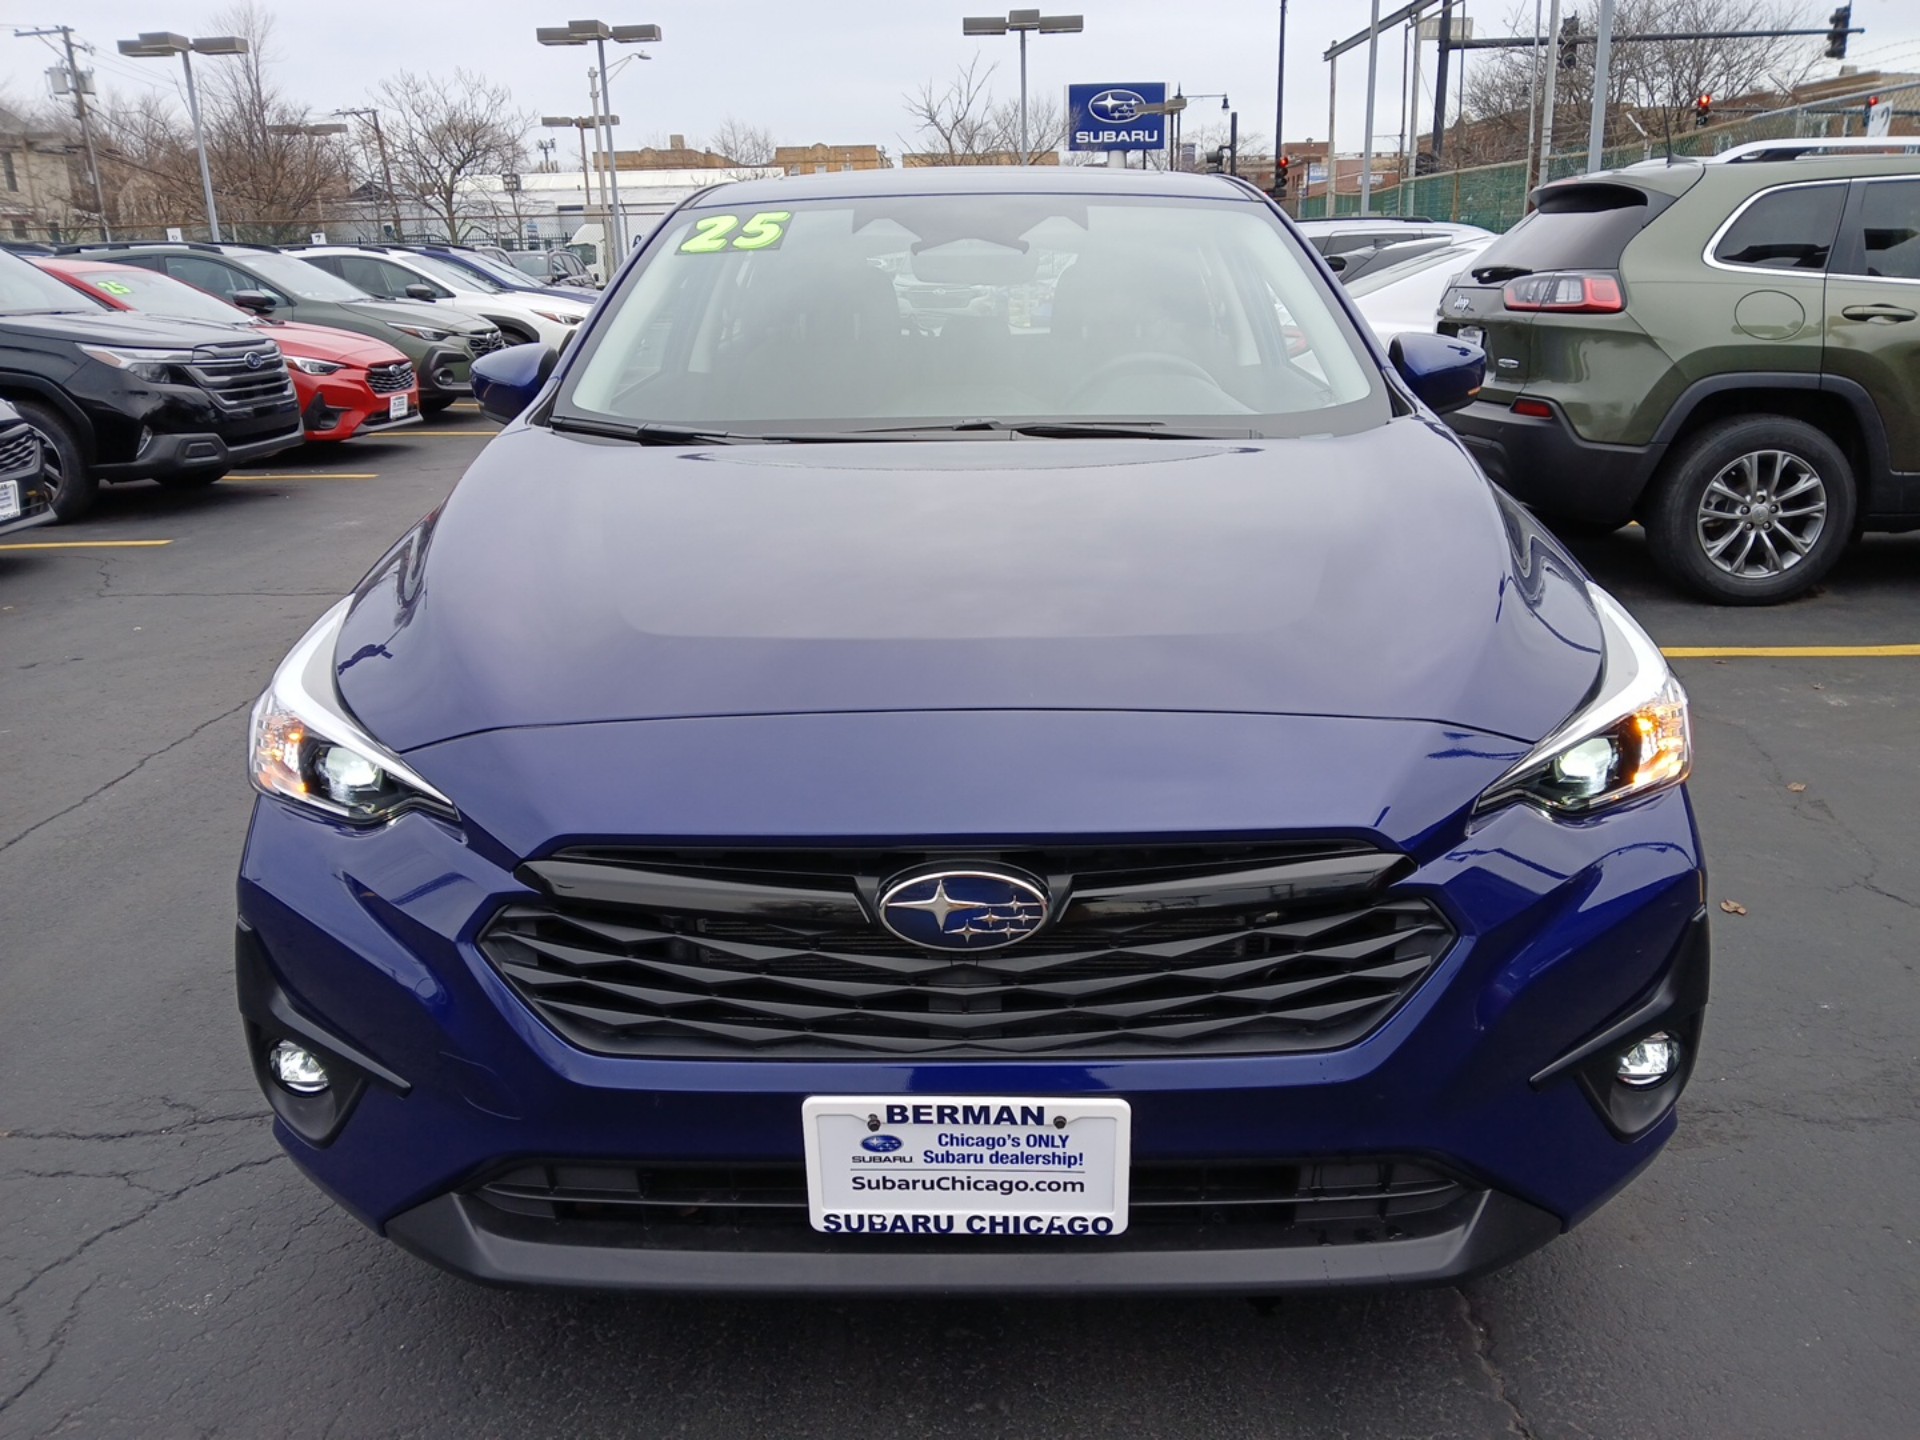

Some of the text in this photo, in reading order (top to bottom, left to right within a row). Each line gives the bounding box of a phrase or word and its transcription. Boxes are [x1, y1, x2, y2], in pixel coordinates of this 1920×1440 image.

[1075, 130, 1158, 143] SUBARU
[680, 211, 791, 253] 25
[886, 1104, 1045, 1126] BERMAN
[937, 1132, 1070, 1150] Chicago's ONLY
[851, 1155, 913, 1163] SUBARU
[923, 1150, 1084, 1168] Subaru dealership!
[851, 1175, 1085, 1195] SubaruChicago.com
[822, 1214, 1114, 1235] SUBARU CHICAGO
